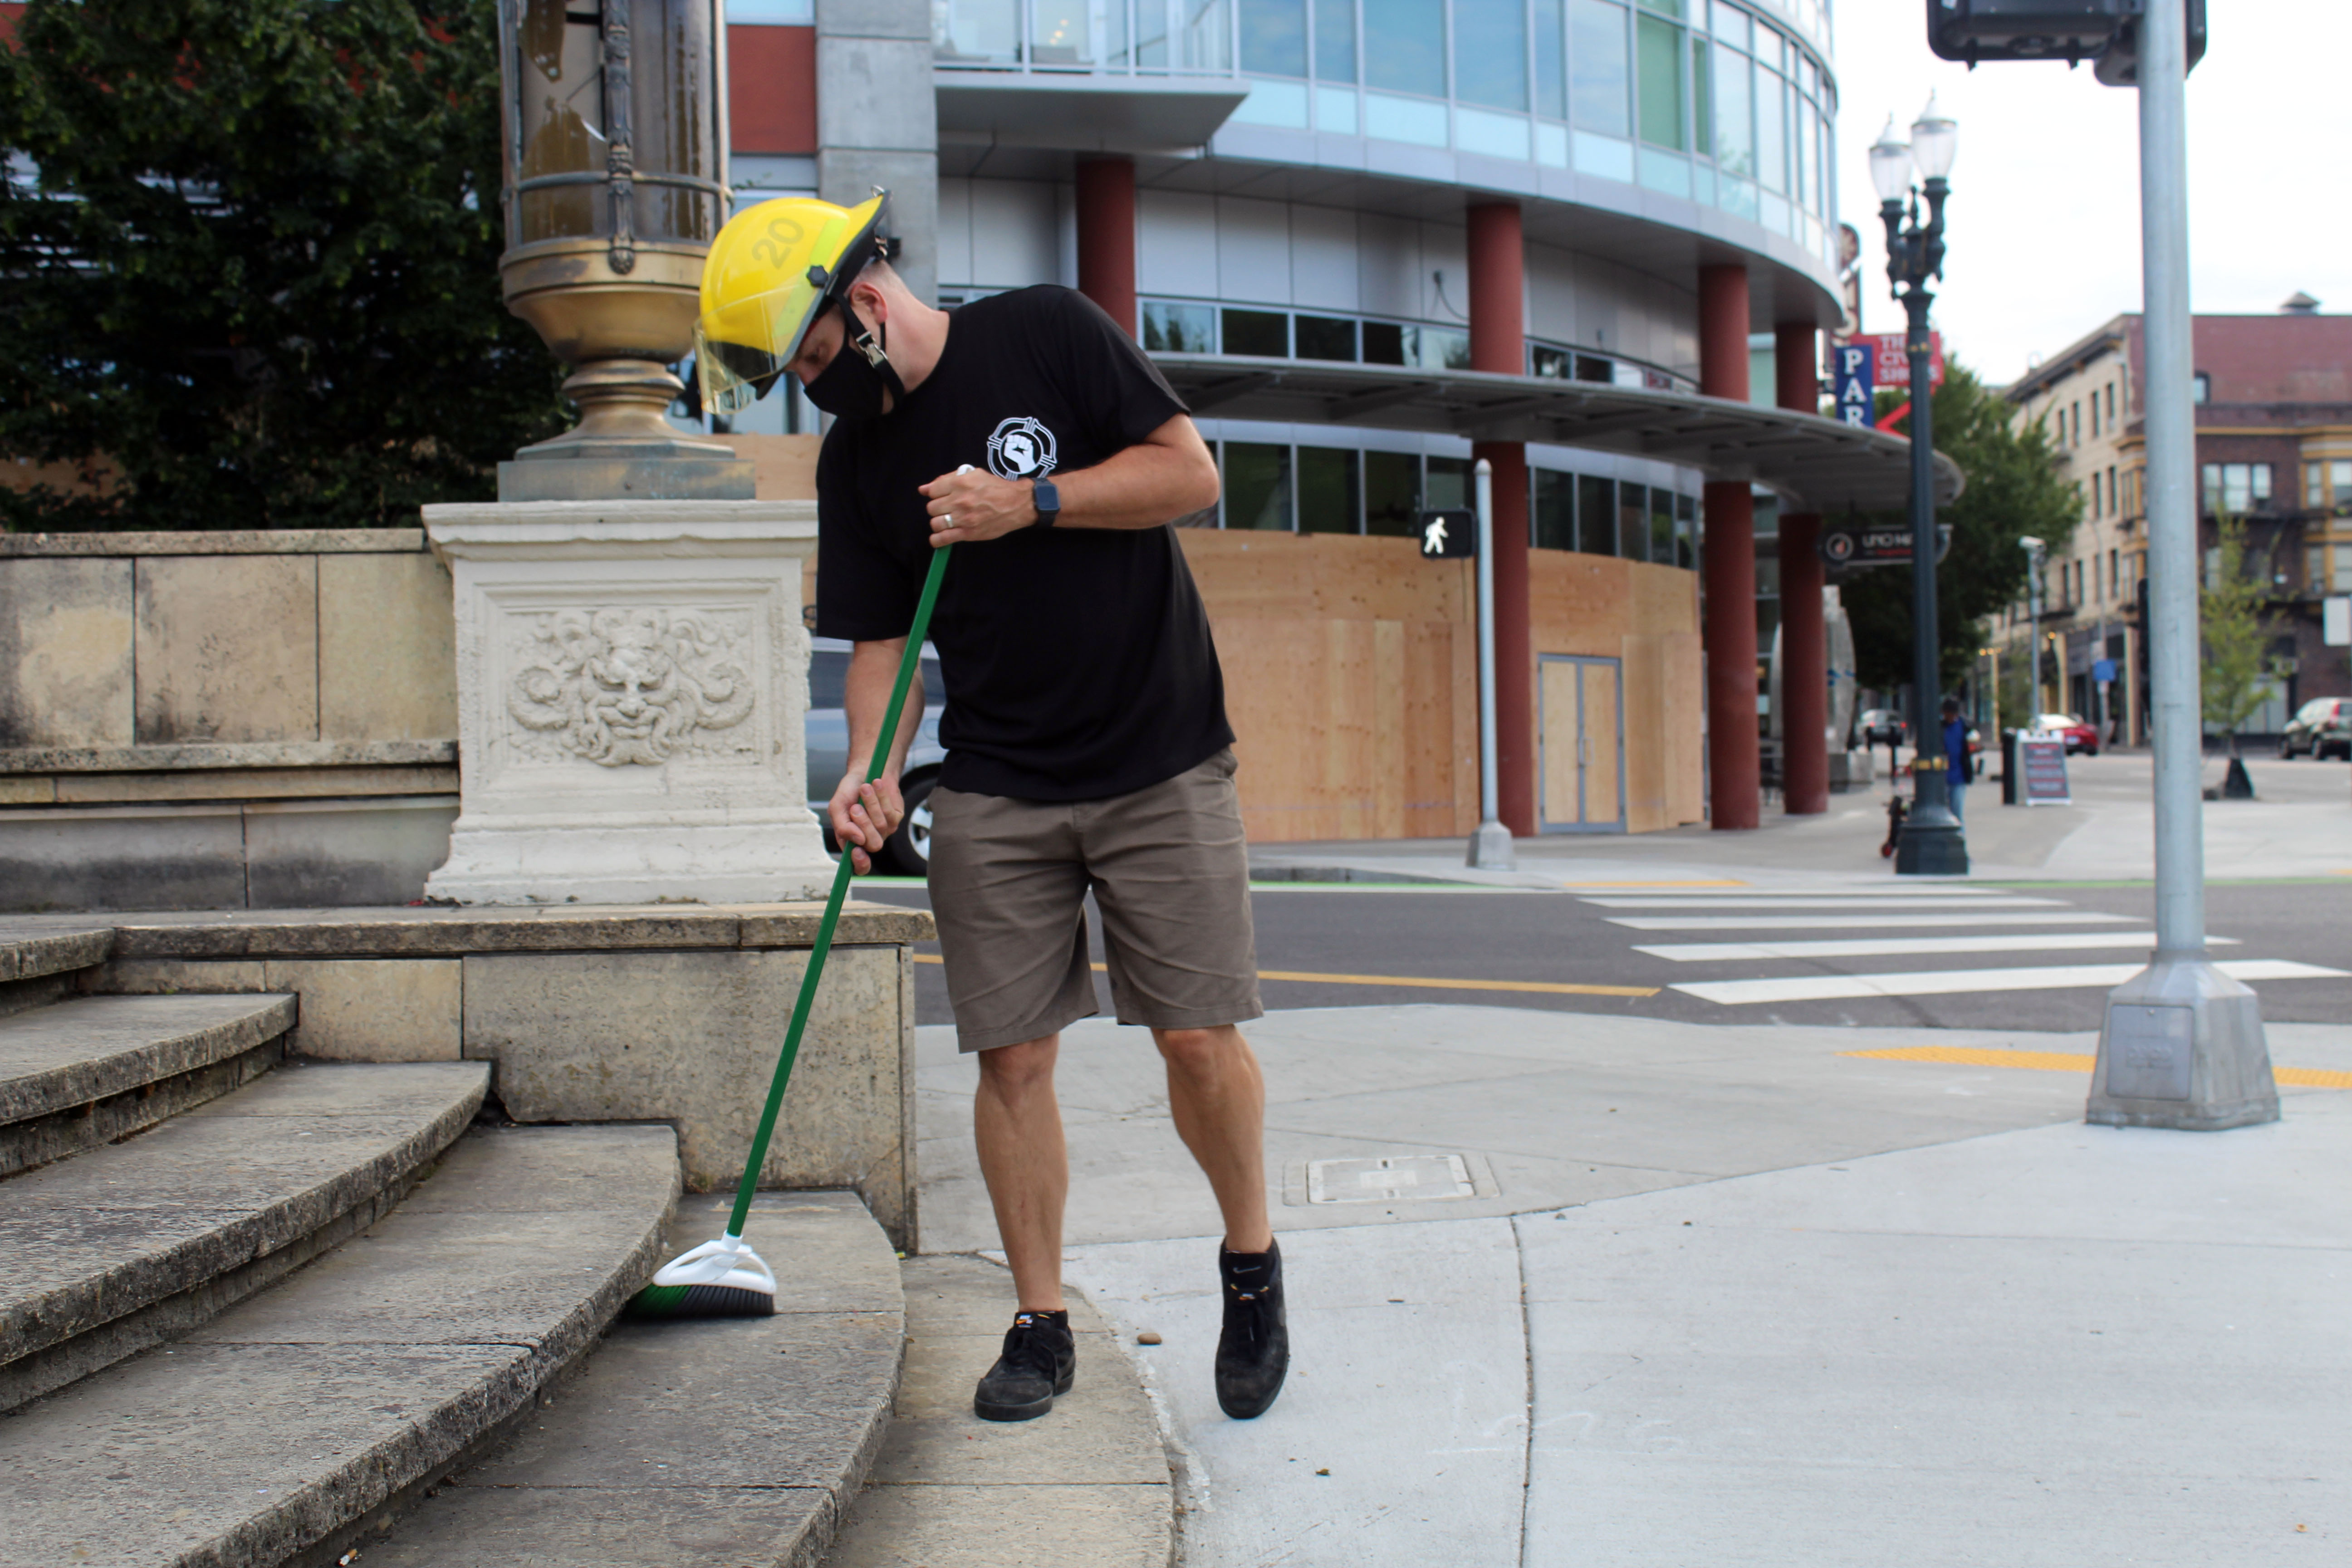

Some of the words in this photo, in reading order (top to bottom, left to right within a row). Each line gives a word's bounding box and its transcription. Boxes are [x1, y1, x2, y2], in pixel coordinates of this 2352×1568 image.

[751, 217, 804, 269] 20
[1878, 335, 1906, 351] TH
[1879, 352, 1909, 367] CIV
